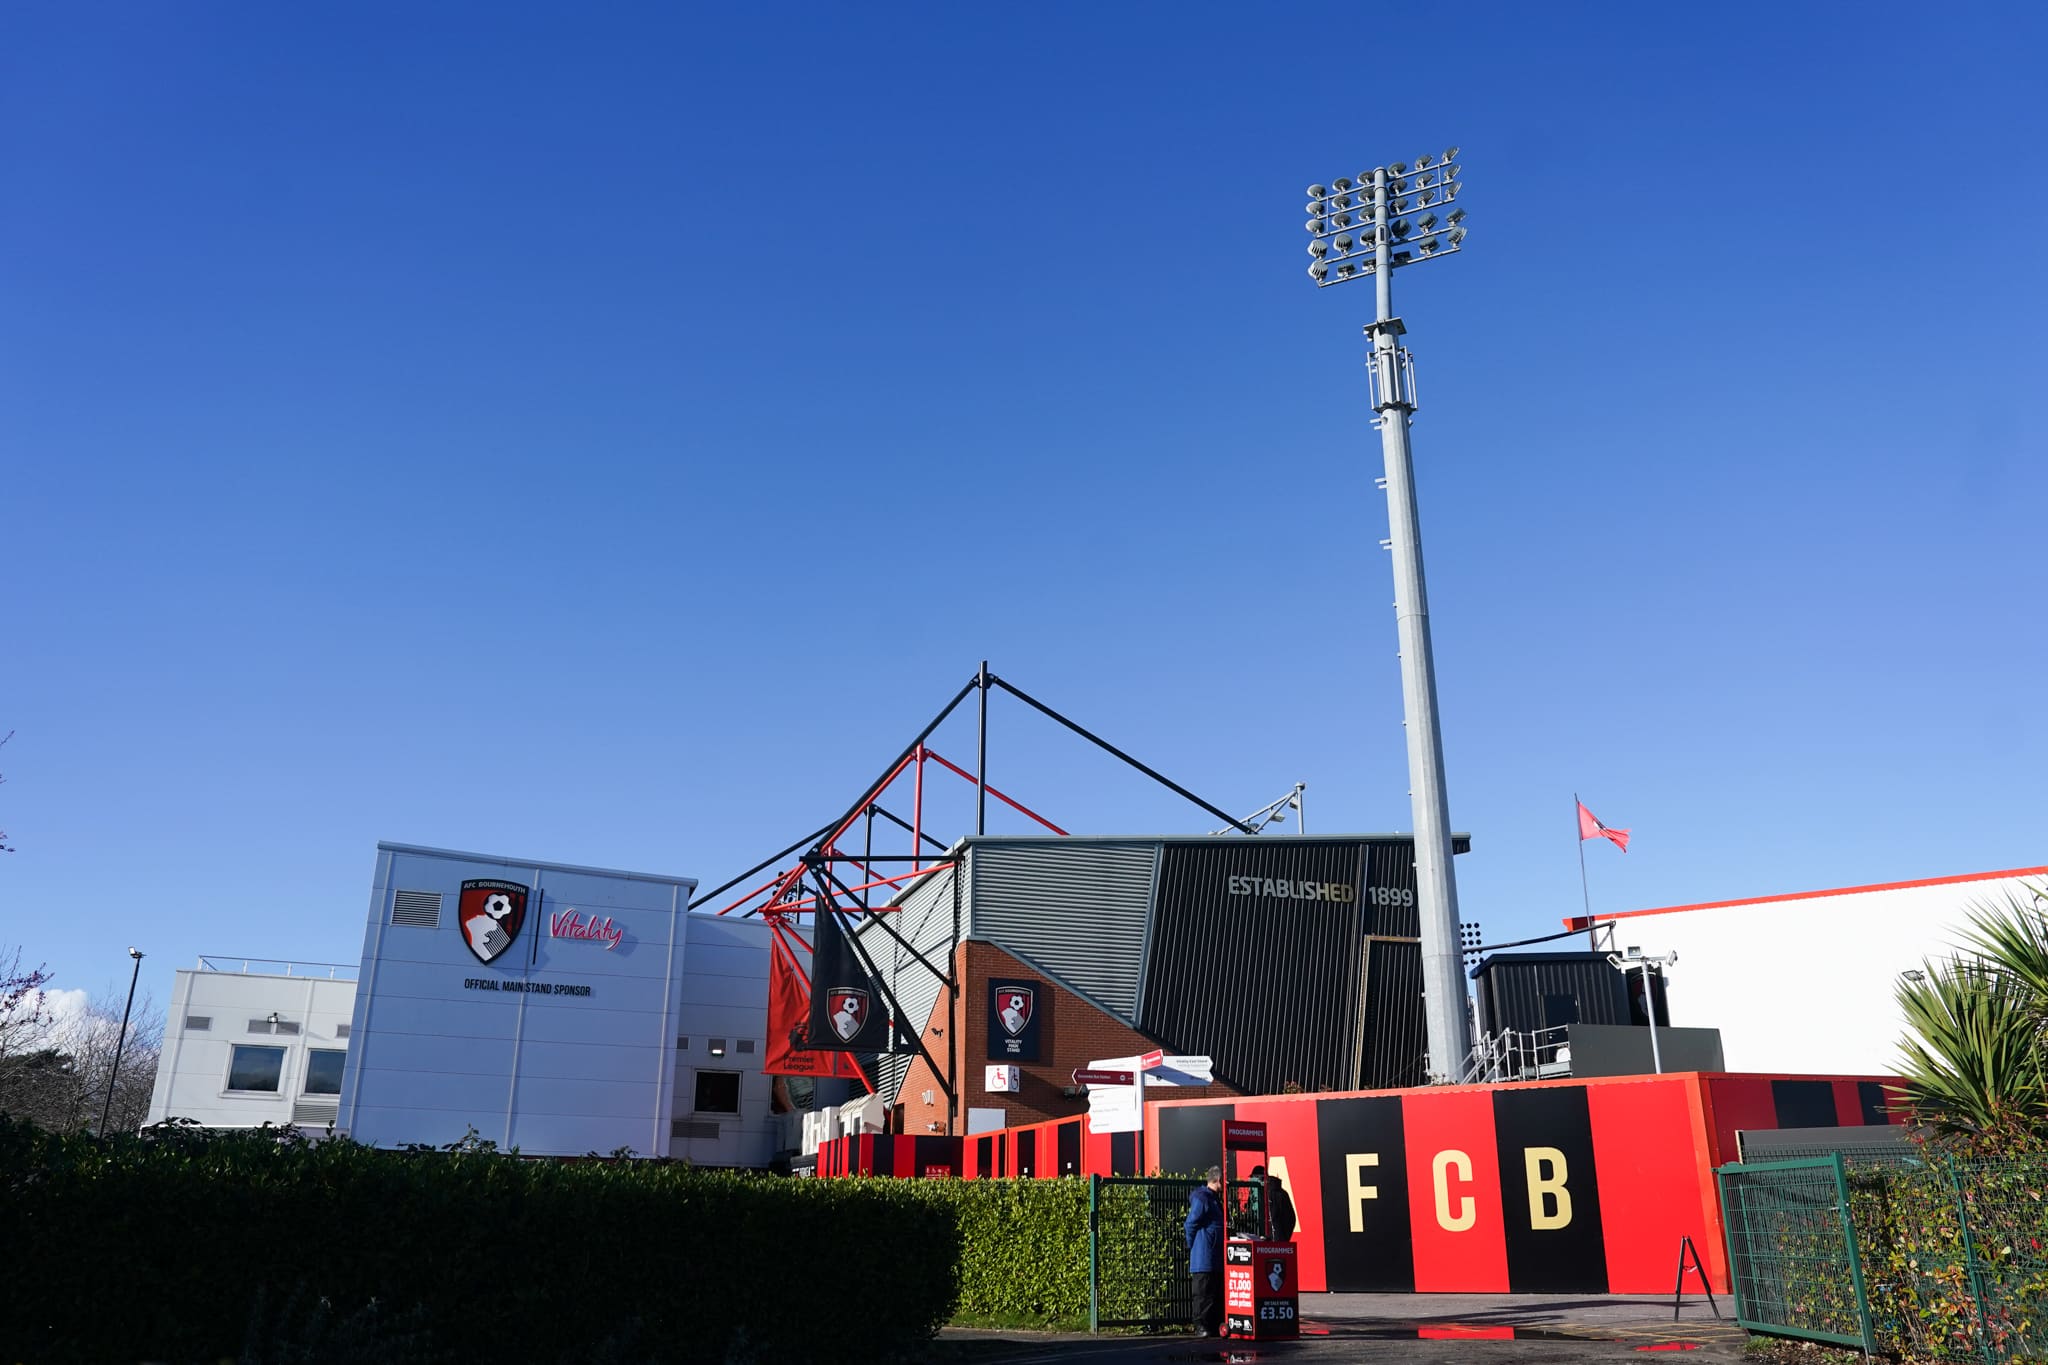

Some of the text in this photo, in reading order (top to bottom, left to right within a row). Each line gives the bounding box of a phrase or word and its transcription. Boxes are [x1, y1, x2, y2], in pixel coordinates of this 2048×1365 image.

[478, 881, 526, 894] BOURNEMOUTH
[1228, 875, 1414, 907] ESTABLISHED 1899
[551, 908, 623, 950] Vitality
[464, 978, 591, 997] OFFICIAL MAIN STAND SPONSOR
[1228, 1128, 1264, 1137] PROGRAMMES
[1256, 1246, 1293, 1254] PROGRAMMES
[1228, 1279, 1251, 1291] £1,000
[1260, 1306, 1294, 1319] £3.50
